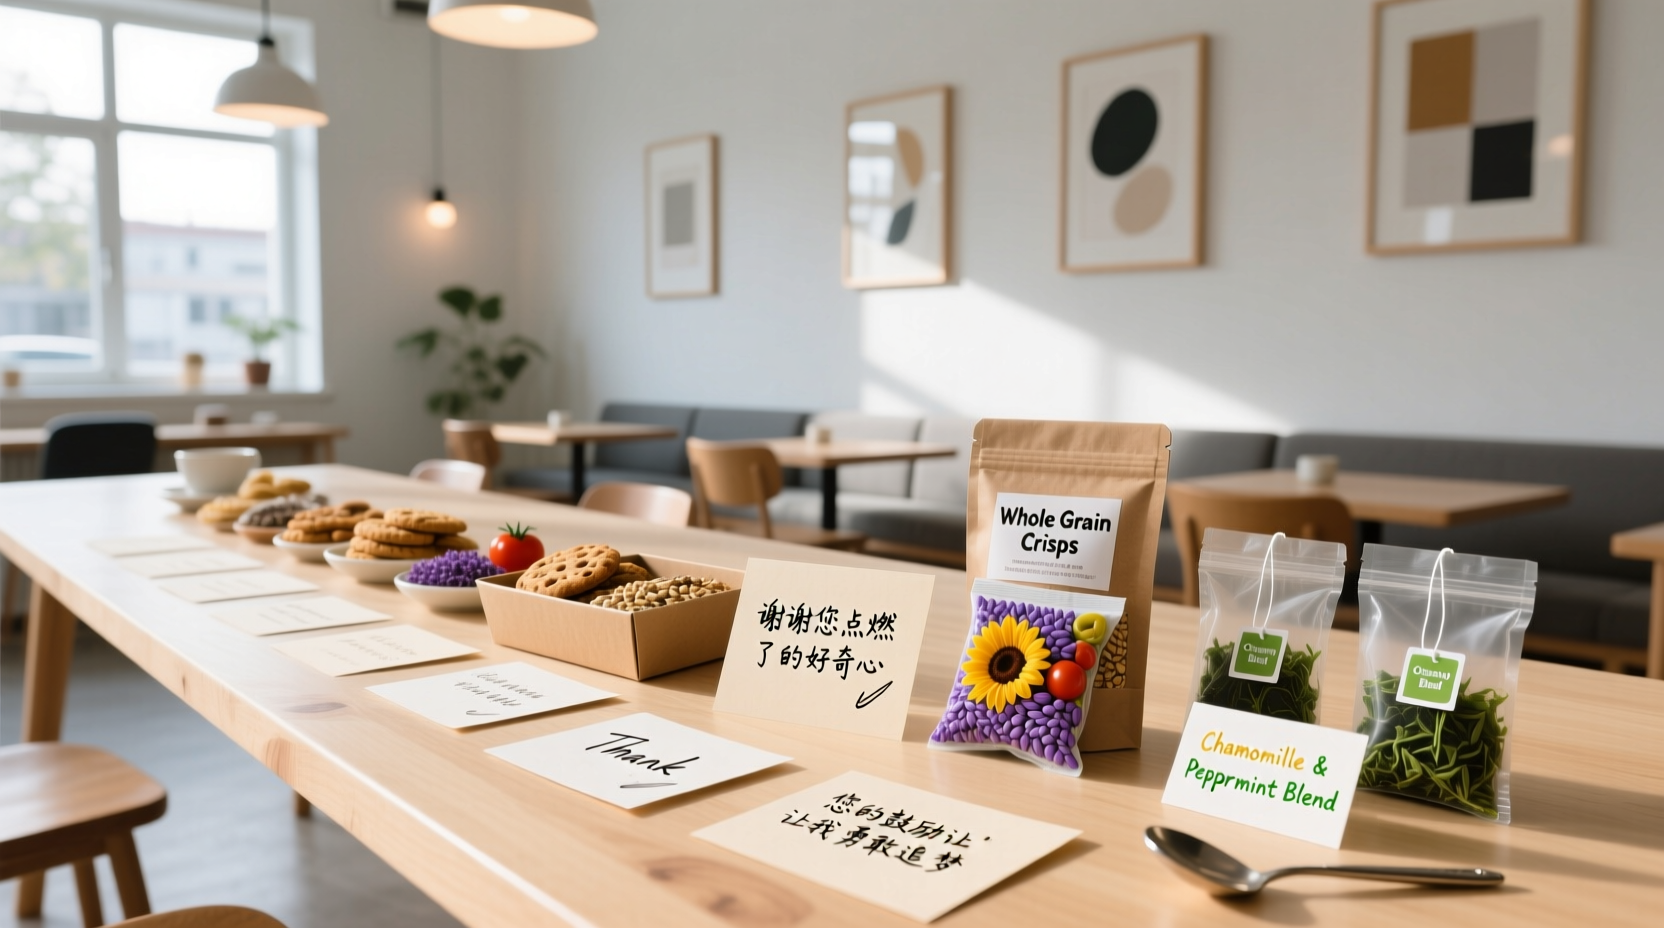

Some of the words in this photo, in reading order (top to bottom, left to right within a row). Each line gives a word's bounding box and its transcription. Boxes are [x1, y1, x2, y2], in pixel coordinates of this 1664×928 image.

[1000, 506, 1055, 528] Whole
[1060, 509, 1111, 532] Grain
[1021, 532, 1079, 559] Crisps
[757, 598, 897, 641] 谢谢您点燃
[757, 641, 884, 680] 了的好奇心
[585, 732, 700, 776] Thank
[1201, 731, 1305, 771] Chamomille
[1312, 755, 1328, 777] &
[1185, 758, 1278, 792] Pepprmint
[1283, 781, 1339, 812] Blend
[781, 809, 963, 872] 让我勇敢追梦
